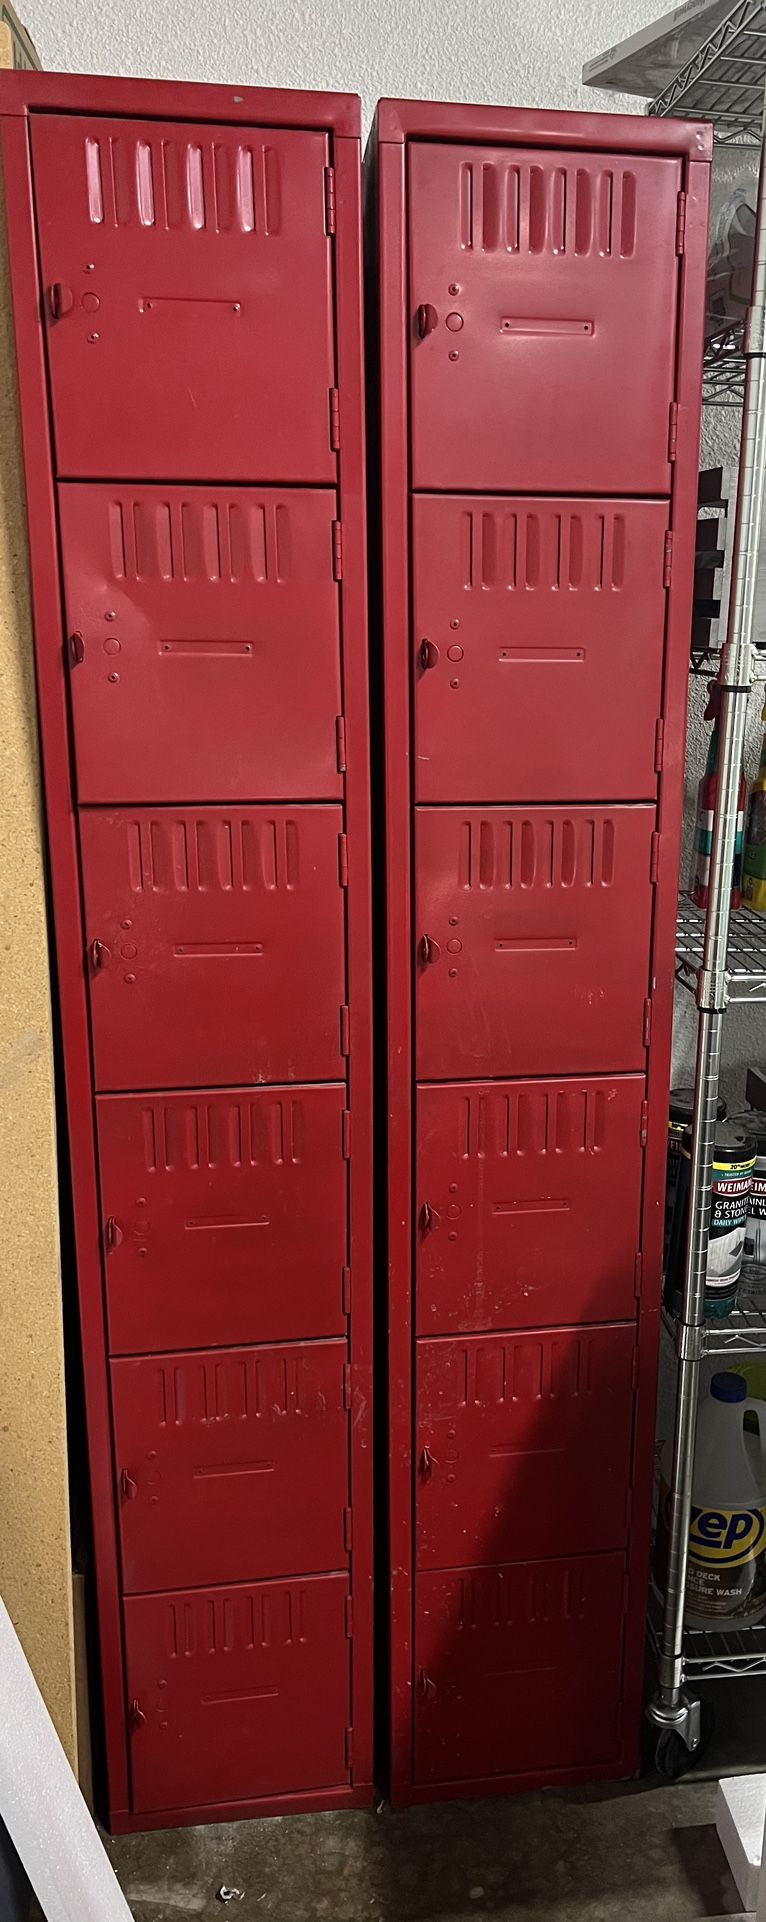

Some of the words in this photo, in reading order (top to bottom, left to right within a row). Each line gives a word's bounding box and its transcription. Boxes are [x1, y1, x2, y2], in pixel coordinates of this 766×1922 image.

[714, 1210, 722, 1218] &
[696, 1570, 720, 1582] DECK
[716, 1588, 742, 1596] WASH
